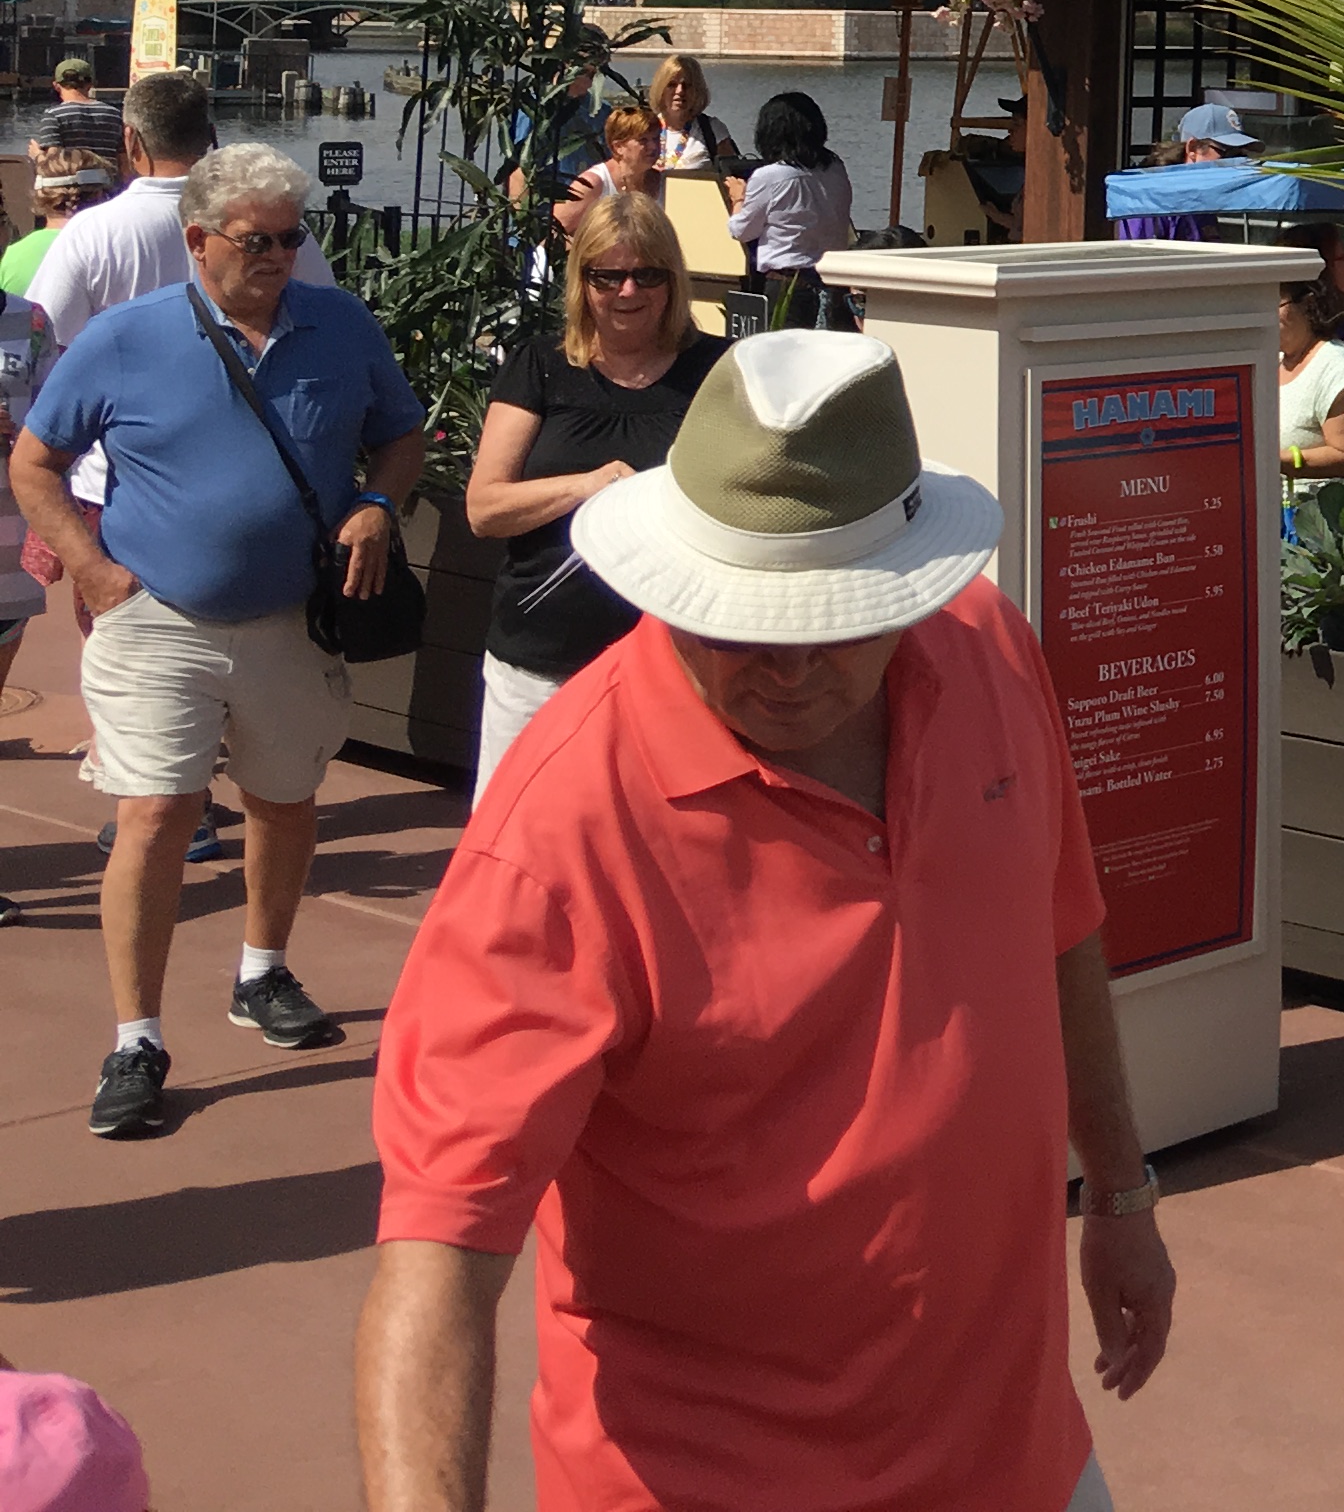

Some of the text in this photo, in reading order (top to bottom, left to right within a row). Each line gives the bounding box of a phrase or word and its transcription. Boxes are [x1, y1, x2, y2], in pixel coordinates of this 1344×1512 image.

[323, 149, 360, 157] PLEASE
[732, 313, 758, 339] EXIT
[1072, 389, 1215, 430] HANAMI
[1120, 475, 1170, 498] MENU
[1068, 497, 1222, 527] Frushi 5.25
[1068, 544, 1223, 576] Chicken Edamame Bun 5.50
[1068, 585, 1223, 619] Beef Teriyaki Udon 5.95
[1098, 649, 1196, 682] BEVERAGES
[1068, 672, 1224, 712] Sapporo Draft Beer 6.00
[1068, 689, 1224, 728] Yuzu Plum Wine Slushy 7.50
[1071, 728, 1224, 772] uigei Sake 6.95
[1107, 773, 1141, 791] Bottled
[1144, 771, 1172, 782] Water
[1204, 757, 1223, 771] 2.75
